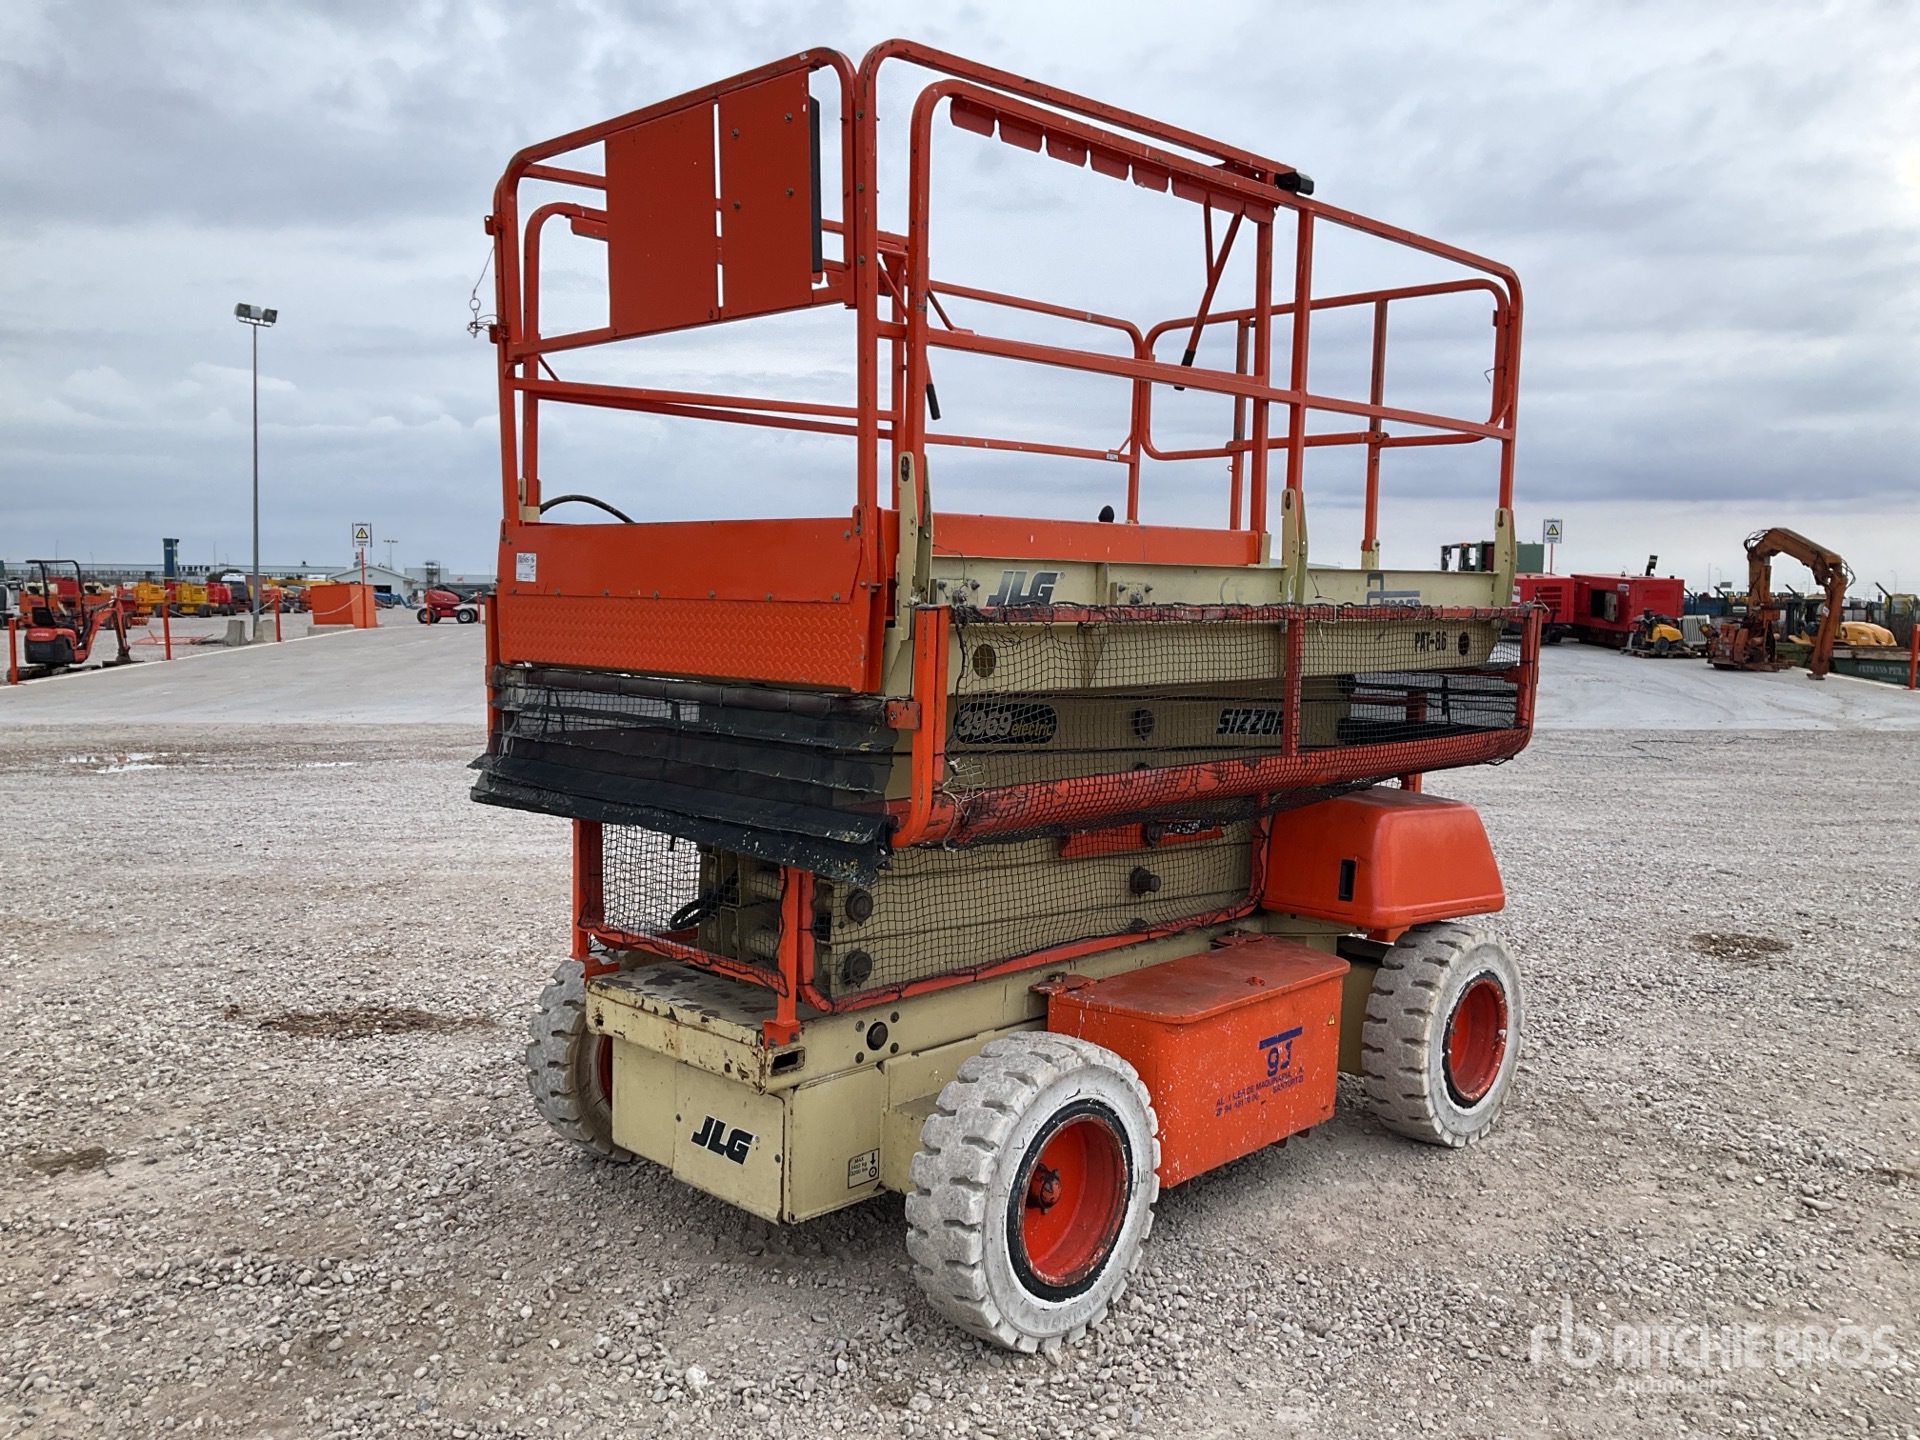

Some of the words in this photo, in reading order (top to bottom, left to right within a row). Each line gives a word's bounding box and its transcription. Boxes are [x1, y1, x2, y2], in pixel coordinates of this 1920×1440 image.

[985, 569, 1060, 607] JLG
[1011, 718, 1055, 738] electric
[689, 1113, 755, 1166] JLG
